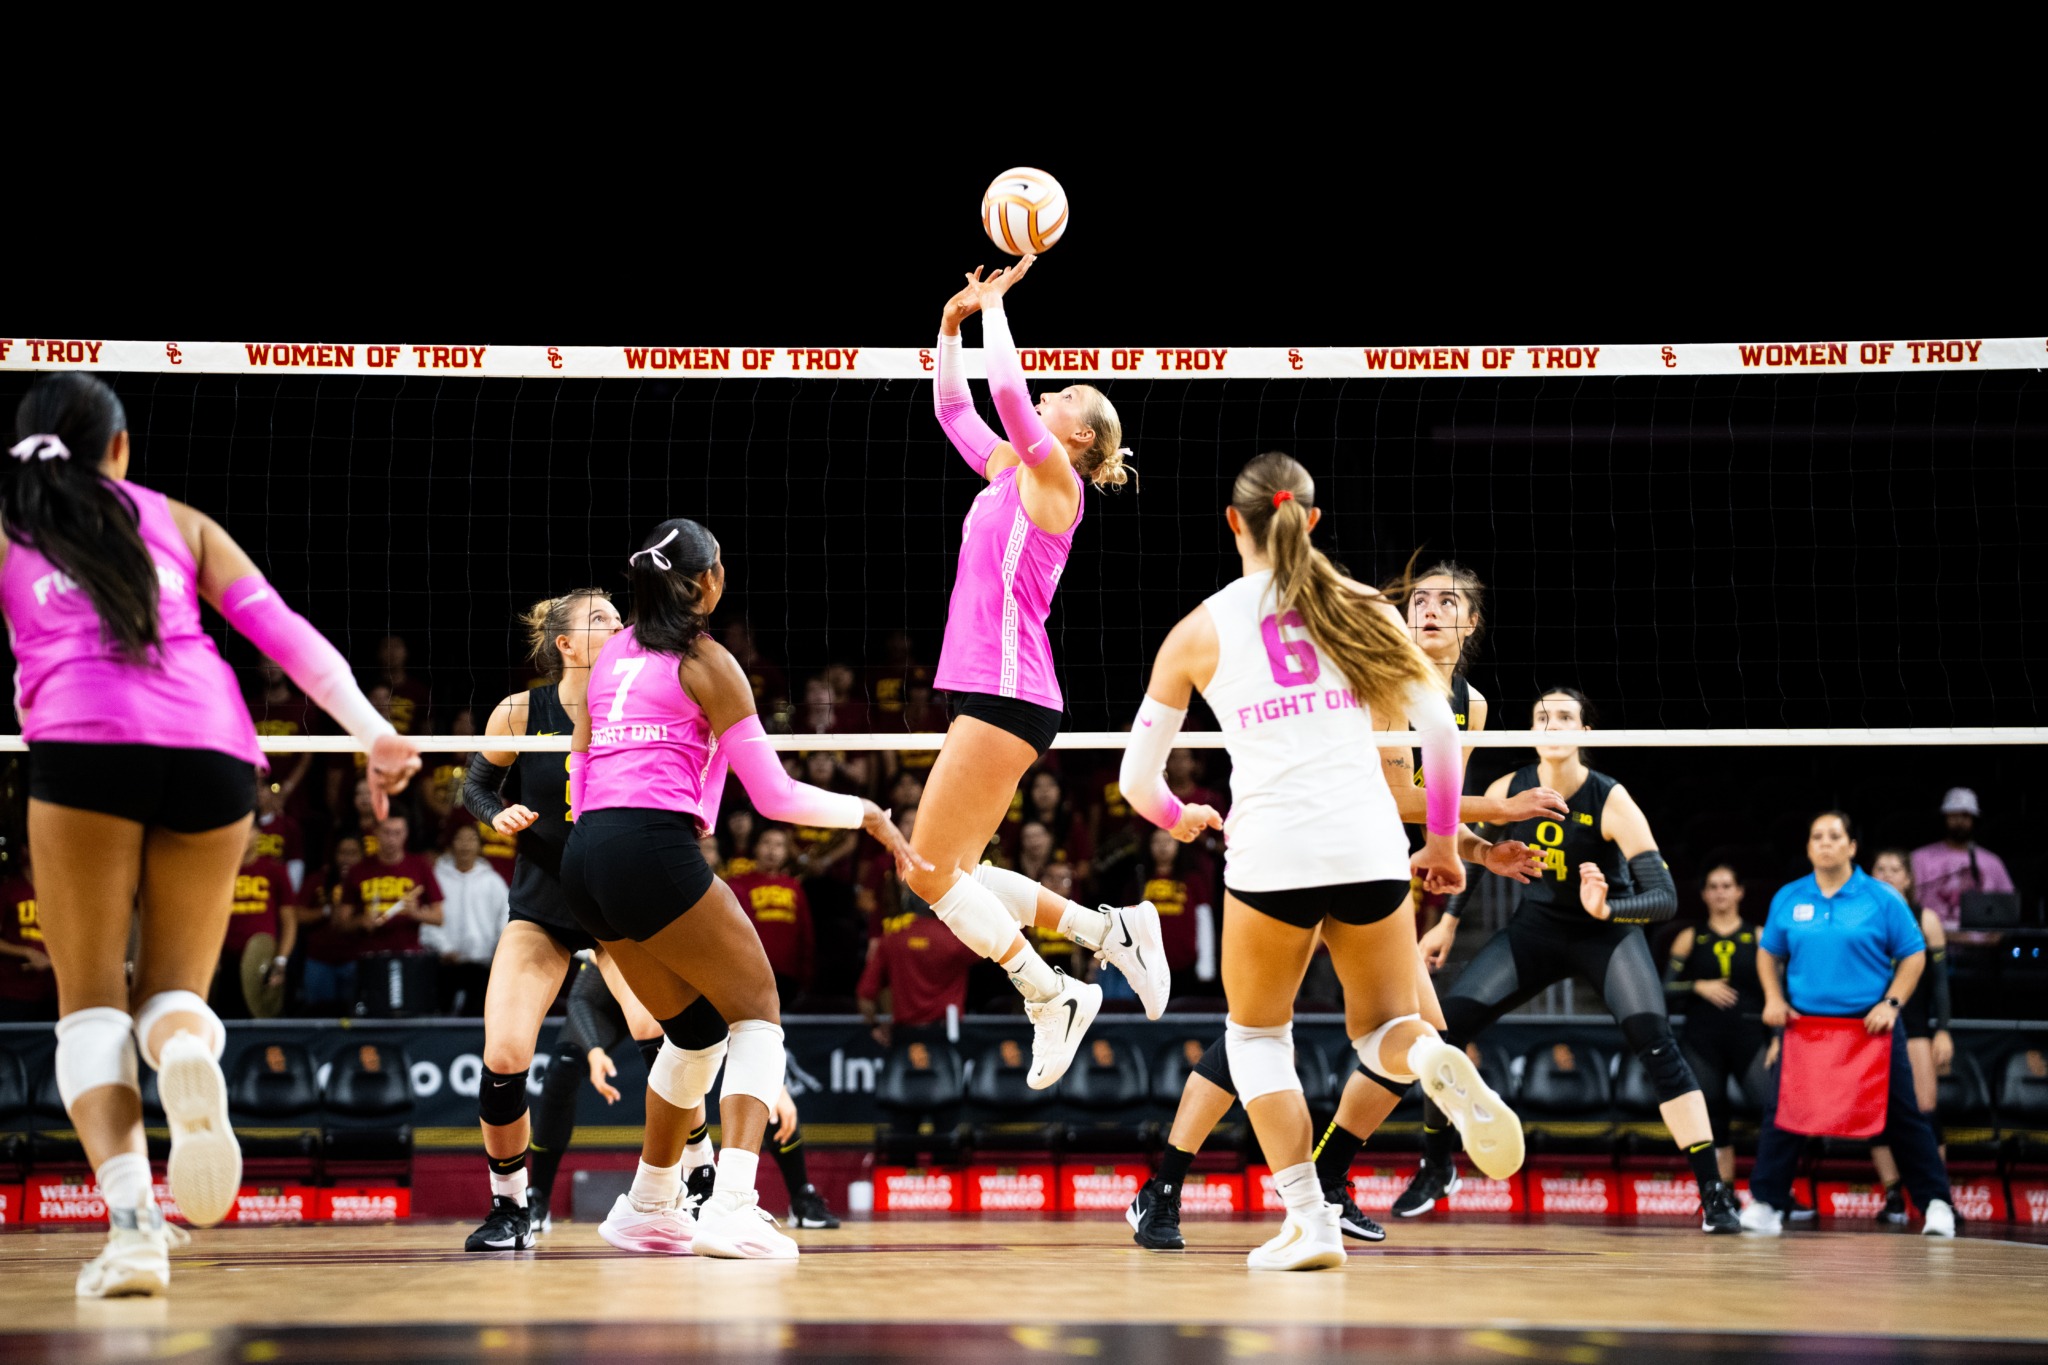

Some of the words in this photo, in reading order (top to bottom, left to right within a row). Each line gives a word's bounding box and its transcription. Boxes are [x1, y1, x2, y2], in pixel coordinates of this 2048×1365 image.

[0, 340, 13, 360] F
[26, 340, 103, 363] TROY
[245, 344, 355, 368] WOMEN
[367, 346, 402, 368] OF
[413, 346, 487, 368] TROY
[624, 348, 730, 370] WOMEN
[742, 349, 775, 370] OF
[787, 349, 859, 370] TROY
[1018, 349, 1100, 371] OMEN
[1111, 349, 1144, 370] OF
[1156, 349, 1228, 370] TROY
[1364, 347, 1470, 370] WOMEN
[1482, 347, 1515, 369] OF
[1528, 347, 1600, 369] TROY
[1739, 343, 1848, 367] WOMEN
[1860, 342, 1894, 365] OF
[1907, 341, 1982, 363] TROY
[1260, 609, 1320, 687] 6
[611, 657, 647, 722] 7
[1237, 692, 1316, 728] FIGHT
[631, 725, 667, 740] ON!
[234, 875, 270, 899] SC
[887, 1175, 952, 1190] WELLS
[979, 1175, 1044, 1190] WELLS
[1181, 1184, 1232, 1199] ELLS
[39, 1201, 105, 1218] FARGO
[888, 1191, 952, 1210] FARGO
[980, 1191, 1045, 1210] FARGO
